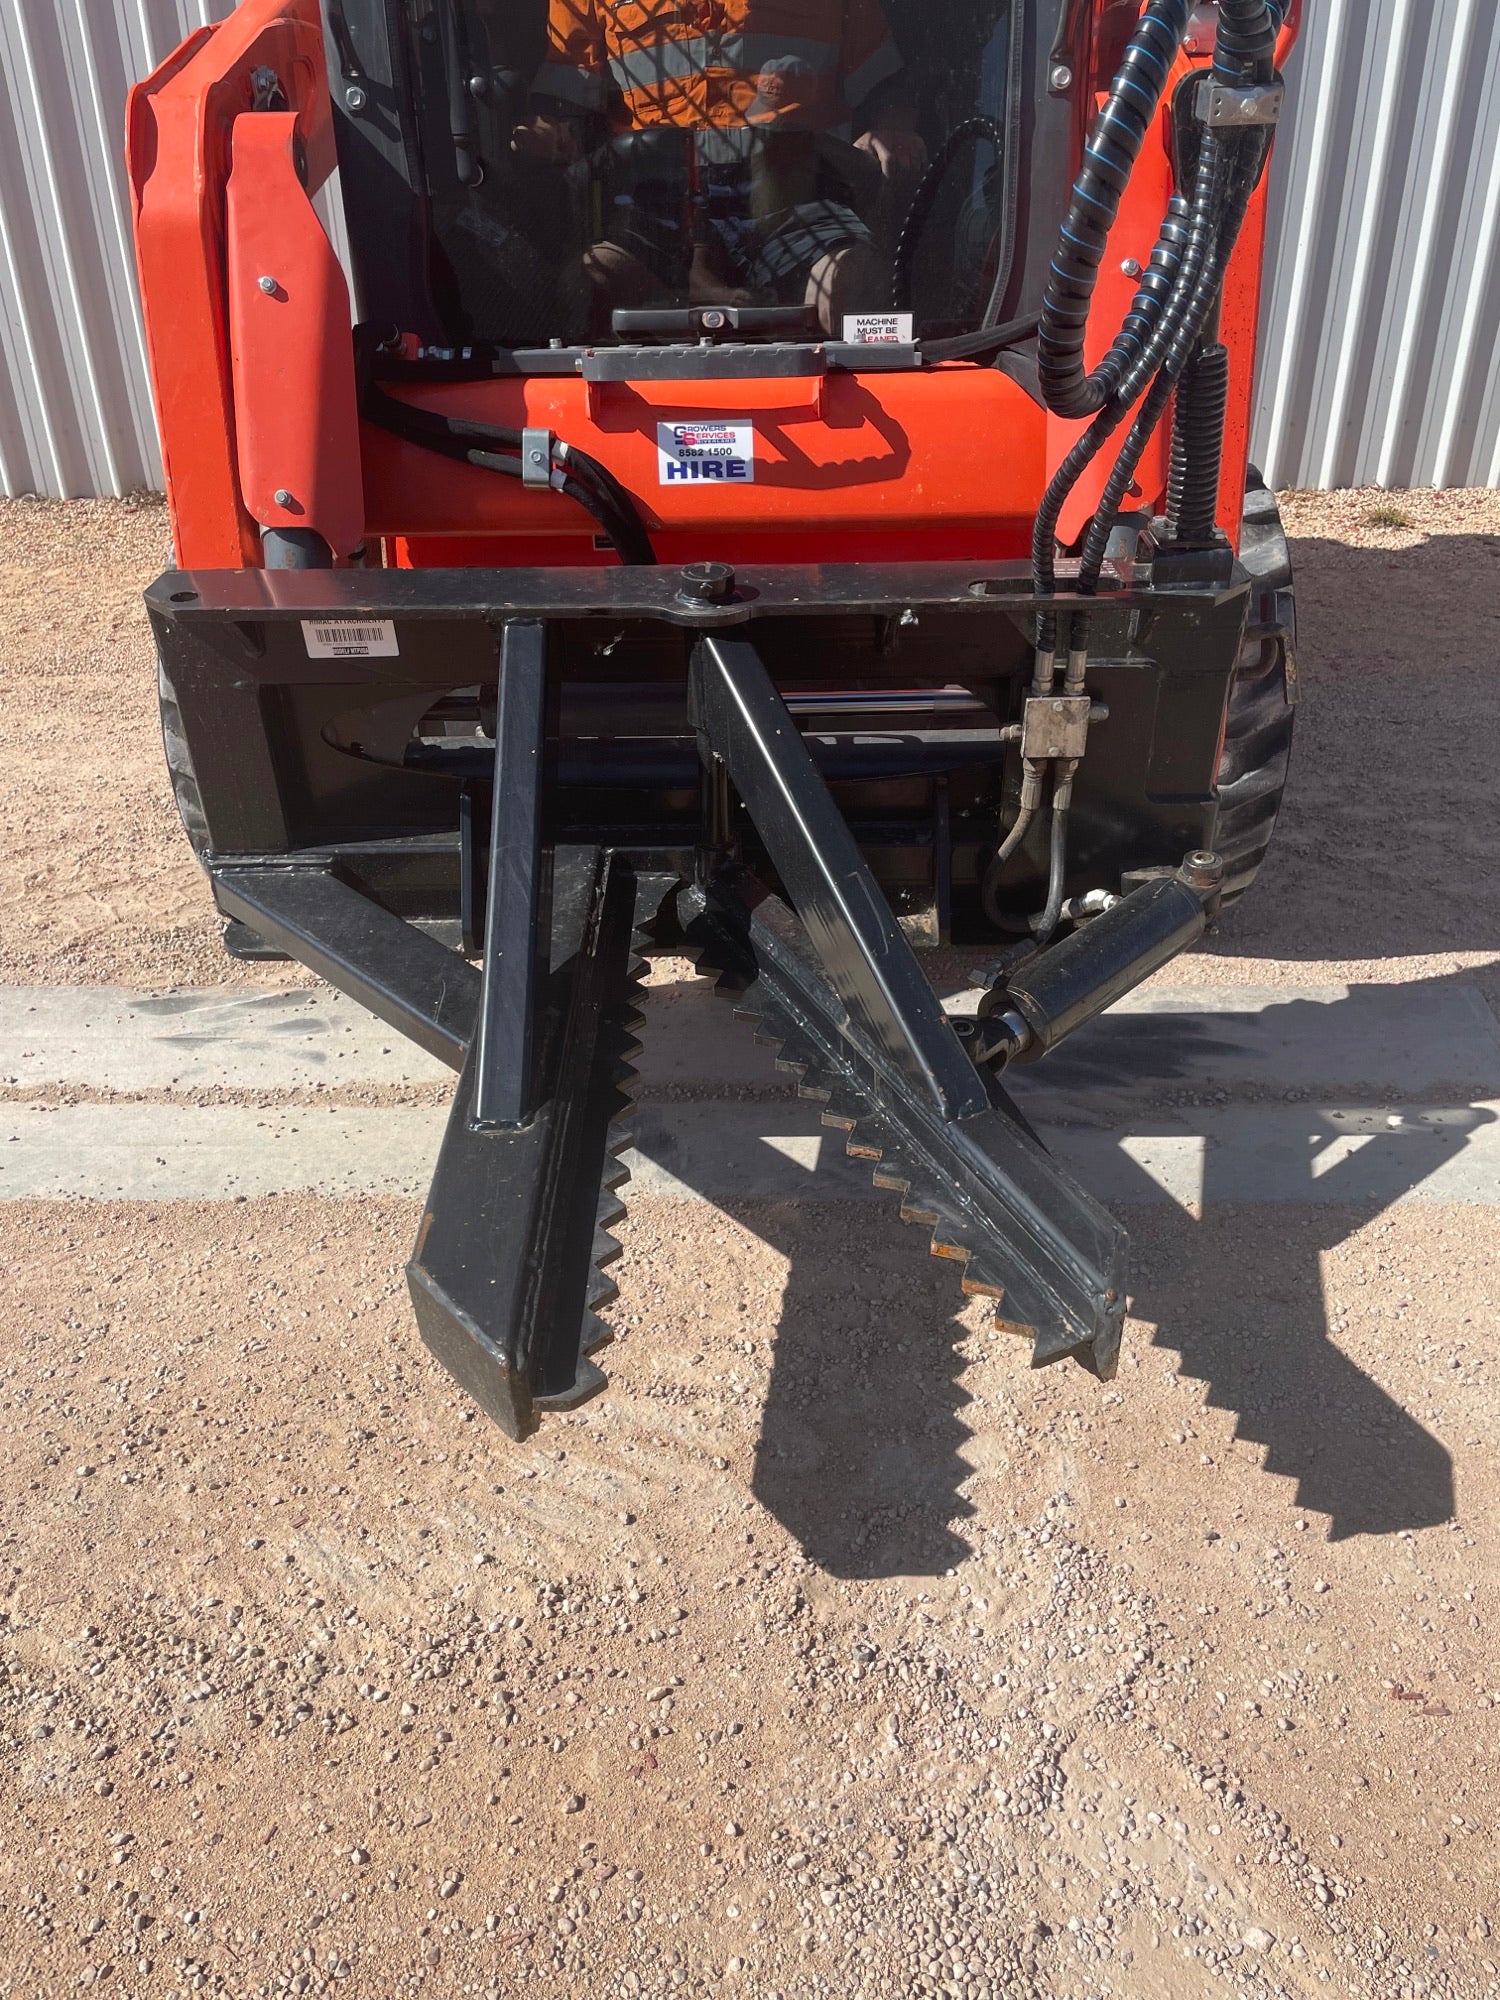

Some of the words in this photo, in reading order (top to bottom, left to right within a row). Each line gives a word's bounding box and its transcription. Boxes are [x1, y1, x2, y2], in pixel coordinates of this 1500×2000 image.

[856, 318, 899, 326] MACHINE
[857, 327, 883, 335] MUST
[674, 425, 727, 438] GROWERS
[683, 432, 735, 446] SERVICES
[678, 448, 704, 457] 8582
[708, 447, 732, 456] 1500
[666, 459, 746, 479] HIRE
